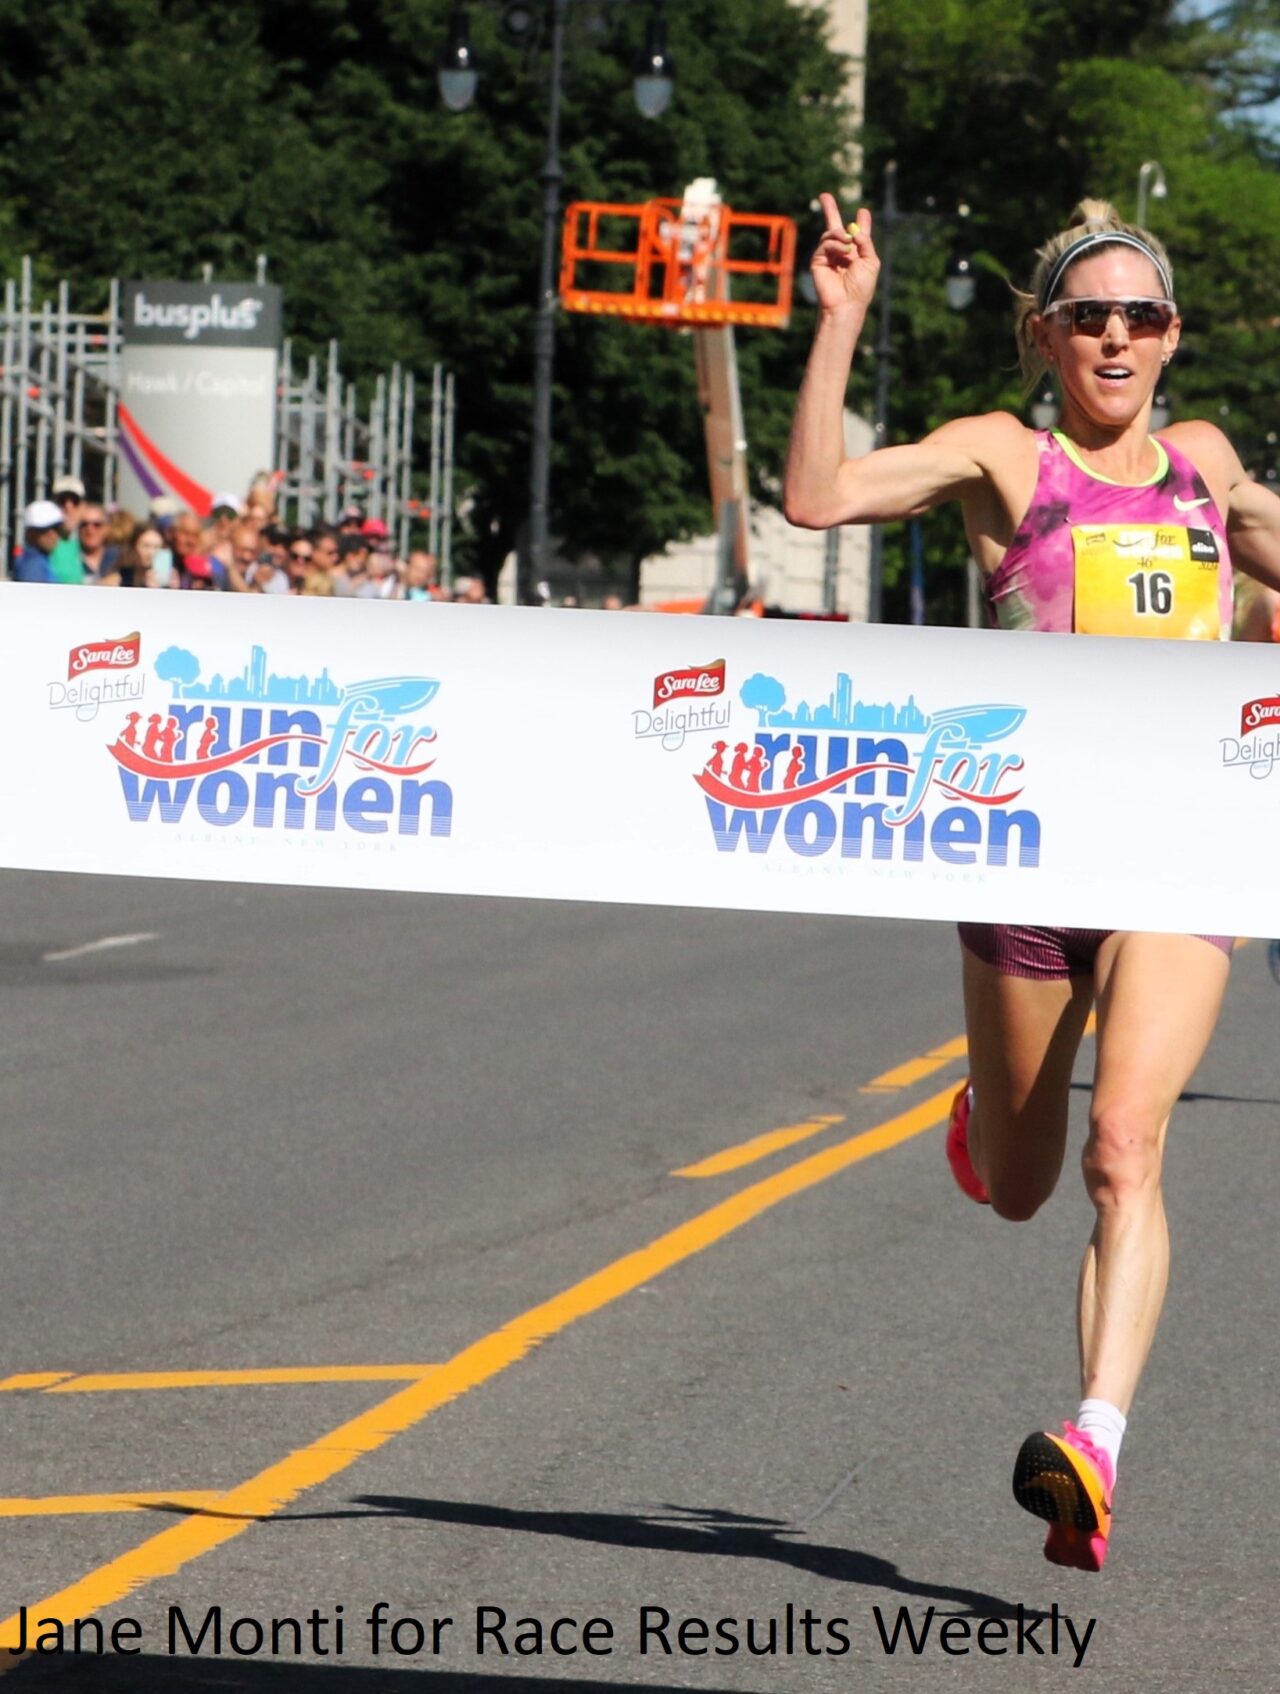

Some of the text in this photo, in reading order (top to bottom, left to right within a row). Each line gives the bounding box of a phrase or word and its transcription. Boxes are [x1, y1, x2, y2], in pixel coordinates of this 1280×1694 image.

[1128, 572, 1172, 615] 16
[47, 674, 146, 724] Delightful
[631, 700, 730, 750] Delightful
[168, 695, 438, 797] run for
[754, 724, 1024, 826] run for
[117, 764, 454, 838] women
[704, 794, 1042, 868] women
